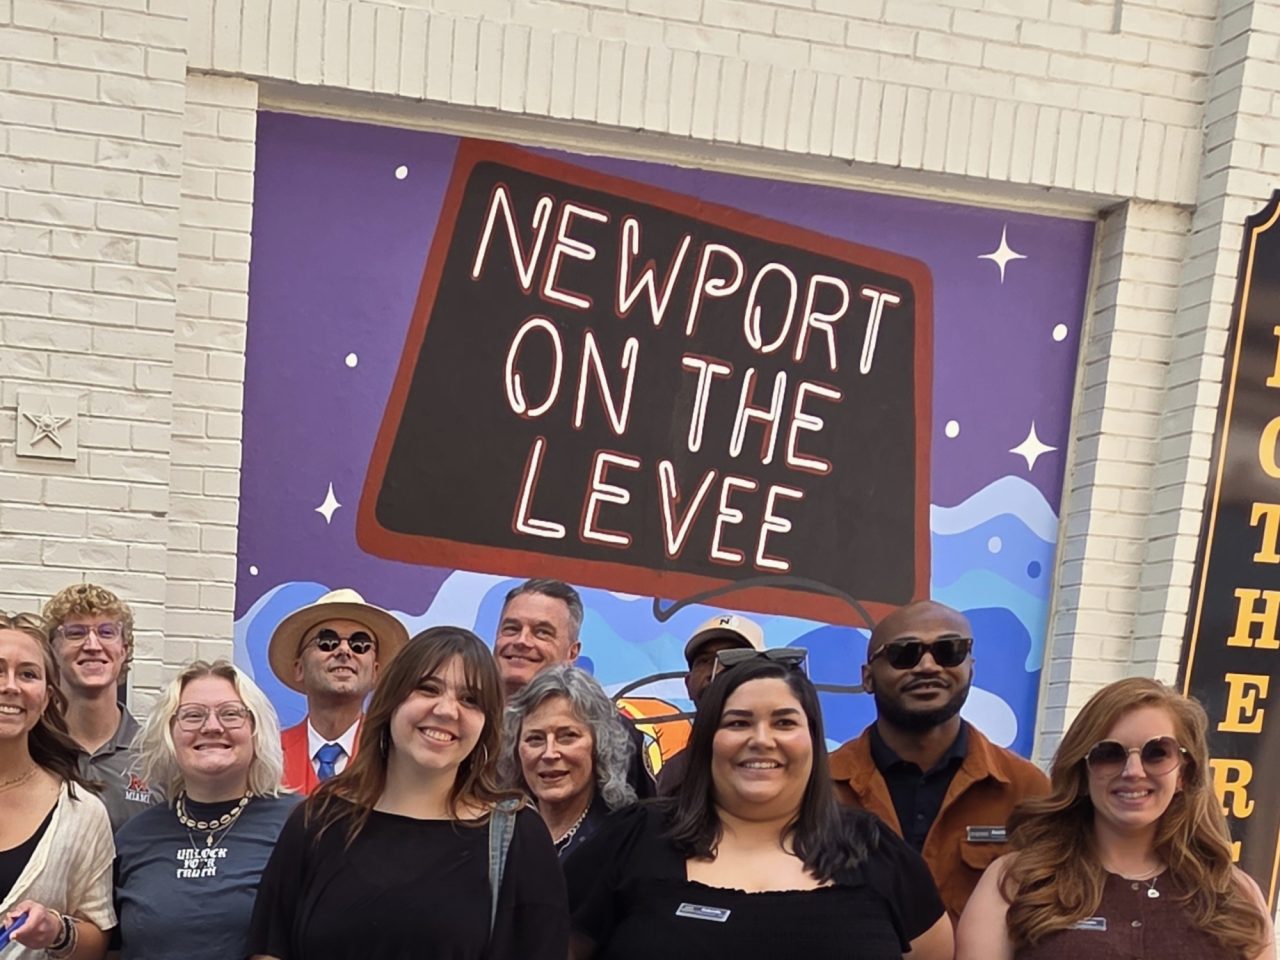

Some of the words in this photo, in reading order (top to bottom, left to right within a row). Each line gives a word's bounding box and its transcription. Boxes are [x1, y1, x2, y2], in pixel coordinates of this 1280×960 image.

[471, 187, 900, 375] NEWPORT
[504, 318, 639, 434] ON
[682, 355, 842, 472] THE
[514, 437, 804, 571] LEVEE
[1209, 325, 1280, 863] THER
[125, 790, 150, 804] MIAMI
